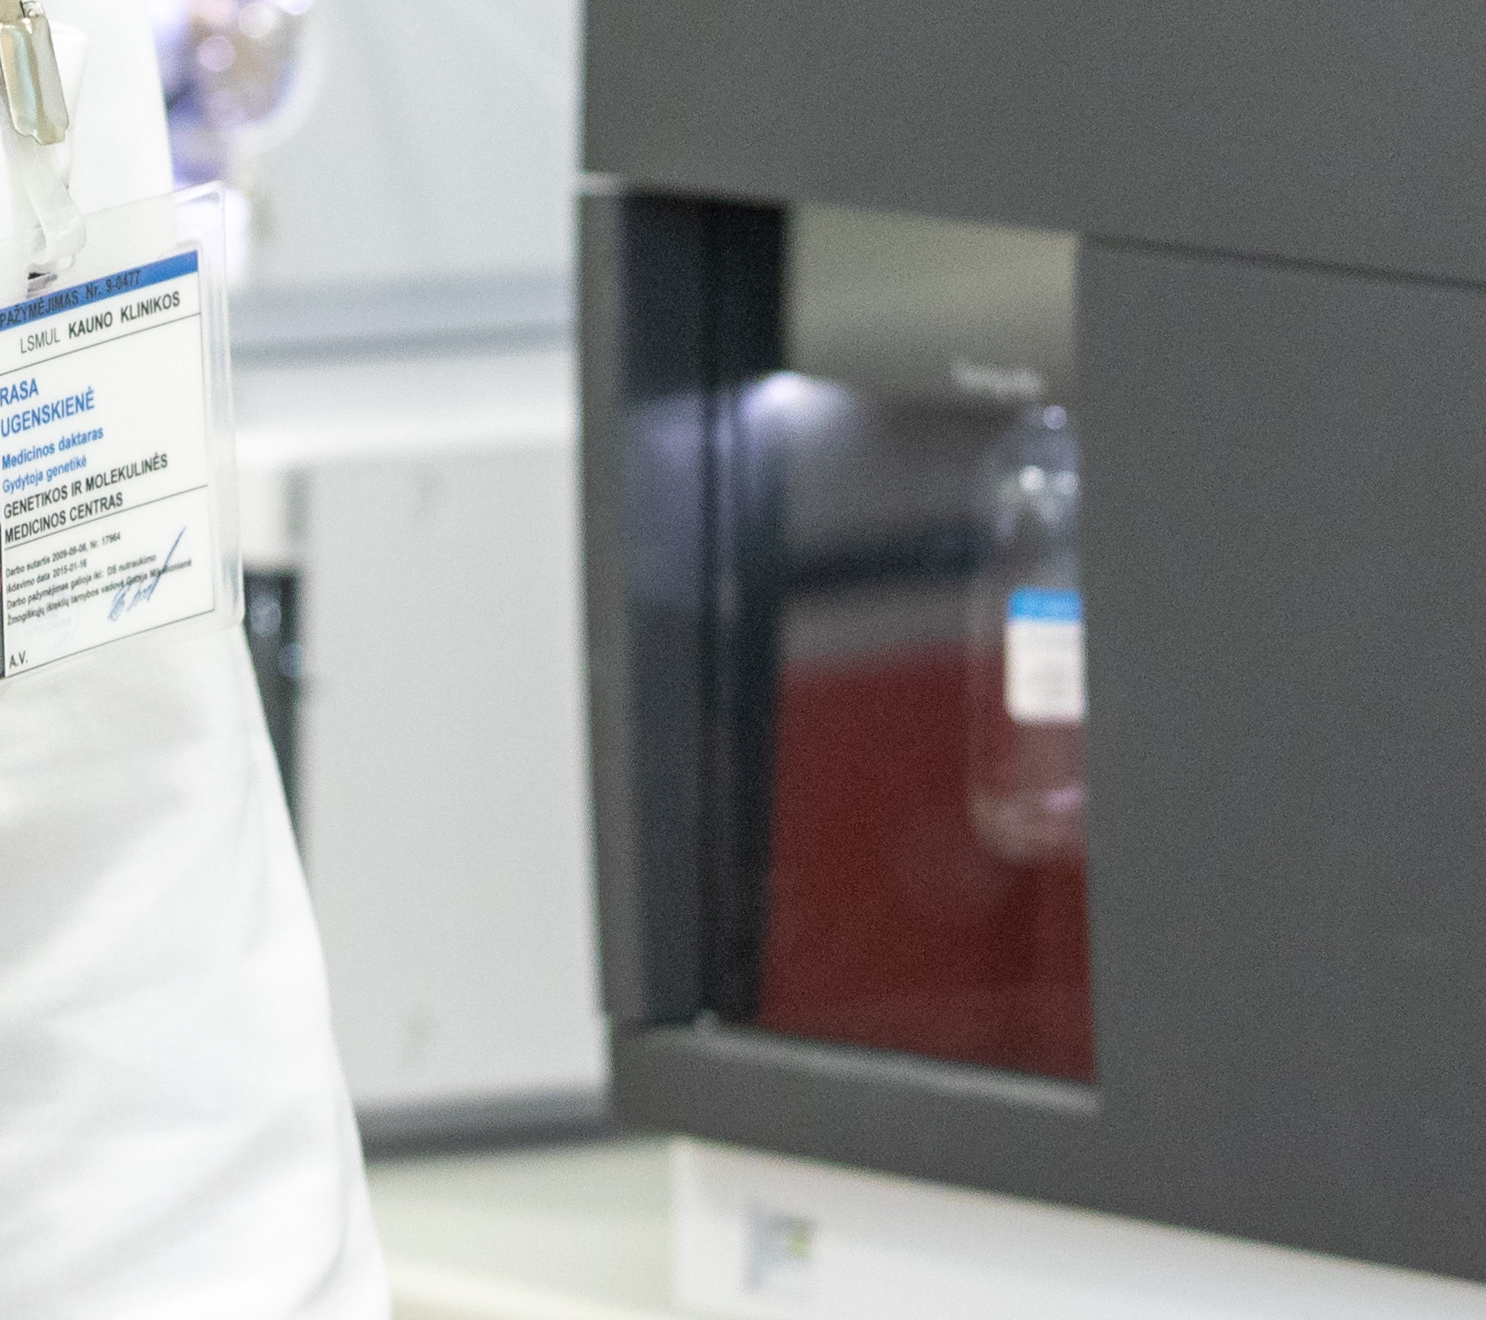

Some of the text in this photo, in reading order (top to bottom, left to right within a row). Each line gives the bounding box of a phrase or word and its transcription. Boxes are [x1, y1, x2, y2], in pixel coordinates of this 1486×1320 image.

[0, 291, 79, 327] PAŽYMĖJIMAS
[85, 285, 100, 301] Nr.
[20, 291, 180, 354] LSMUL KAUNO KLINIKOS
[0, 378, 39, 407] RASA
[0, 386, 95, 438] UGENSKIENĖ
[2, 427, 104, 471] Medicinos daktaras
[2, 455, 87, 495] Gydytoja genetikė
[3, 452, 168, 519] GENETIKOS IR MOLEKULINĖS
[4, 491, 123, 544] MEDICINOS CENTRAS
[5, 564, 25, 578] Darbo
[36, 572, 51, 584] data
[6, 596, 26, 610] Darbo
[70, 574, 92, 591] galioja
[9, 650, 28, 669] A.V.
